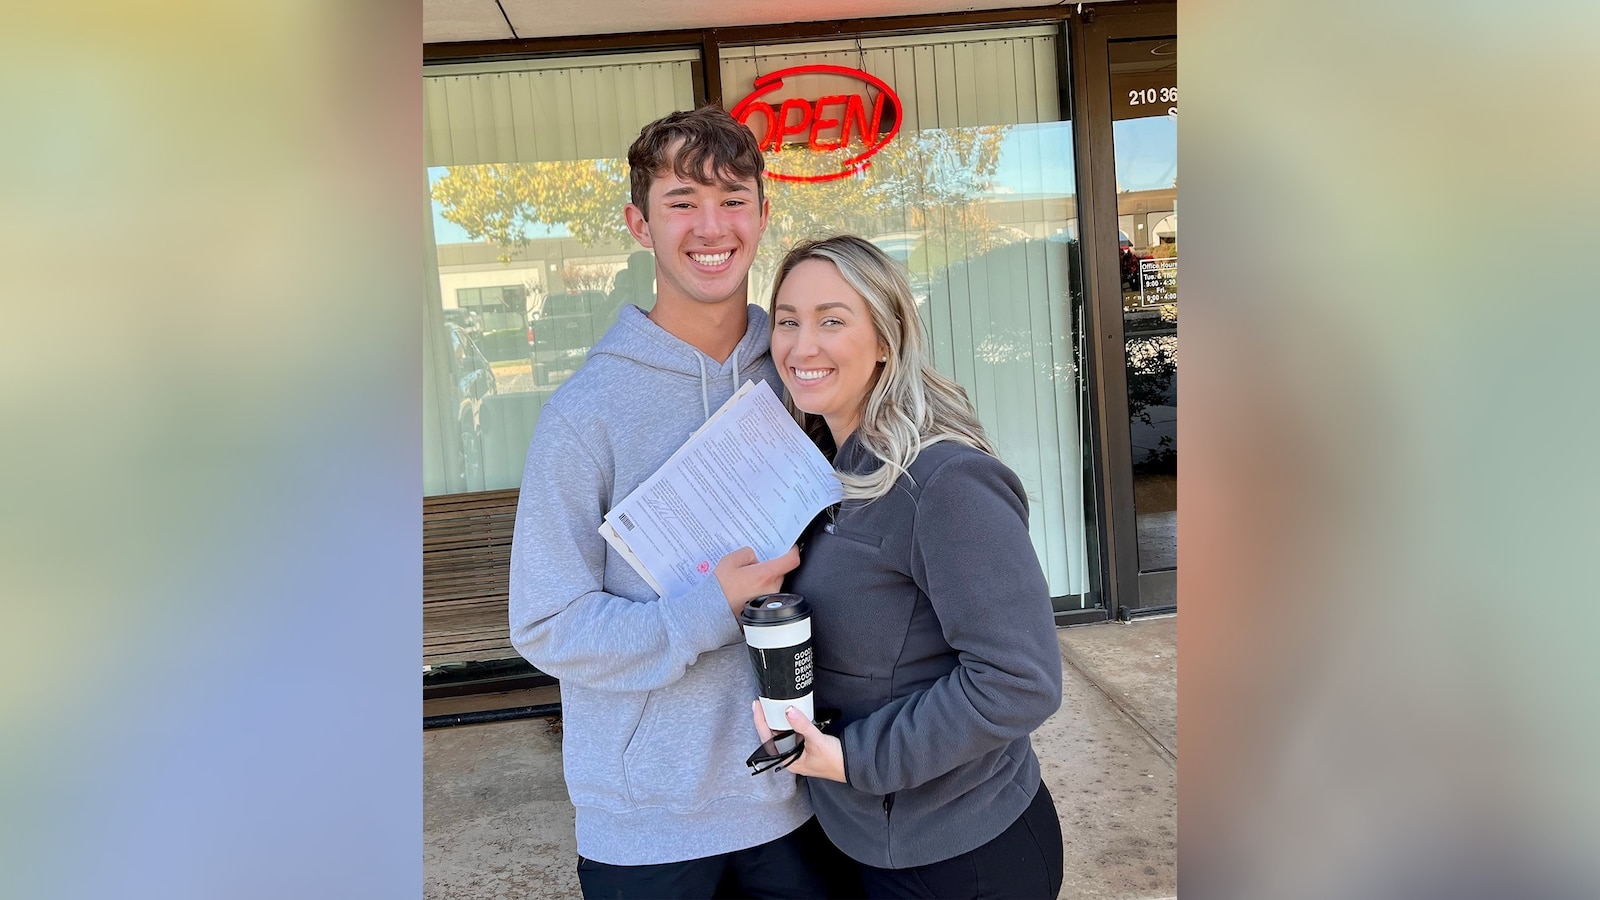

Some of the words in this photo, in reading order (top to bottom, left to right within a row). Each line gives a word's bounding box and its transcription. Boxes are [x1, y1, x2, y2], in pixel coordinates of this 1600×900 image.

[1128, 88, 1157, 106] 210
[1160, 87, 1177, 103] 36
[738, 91, 885, 153] OPEN
